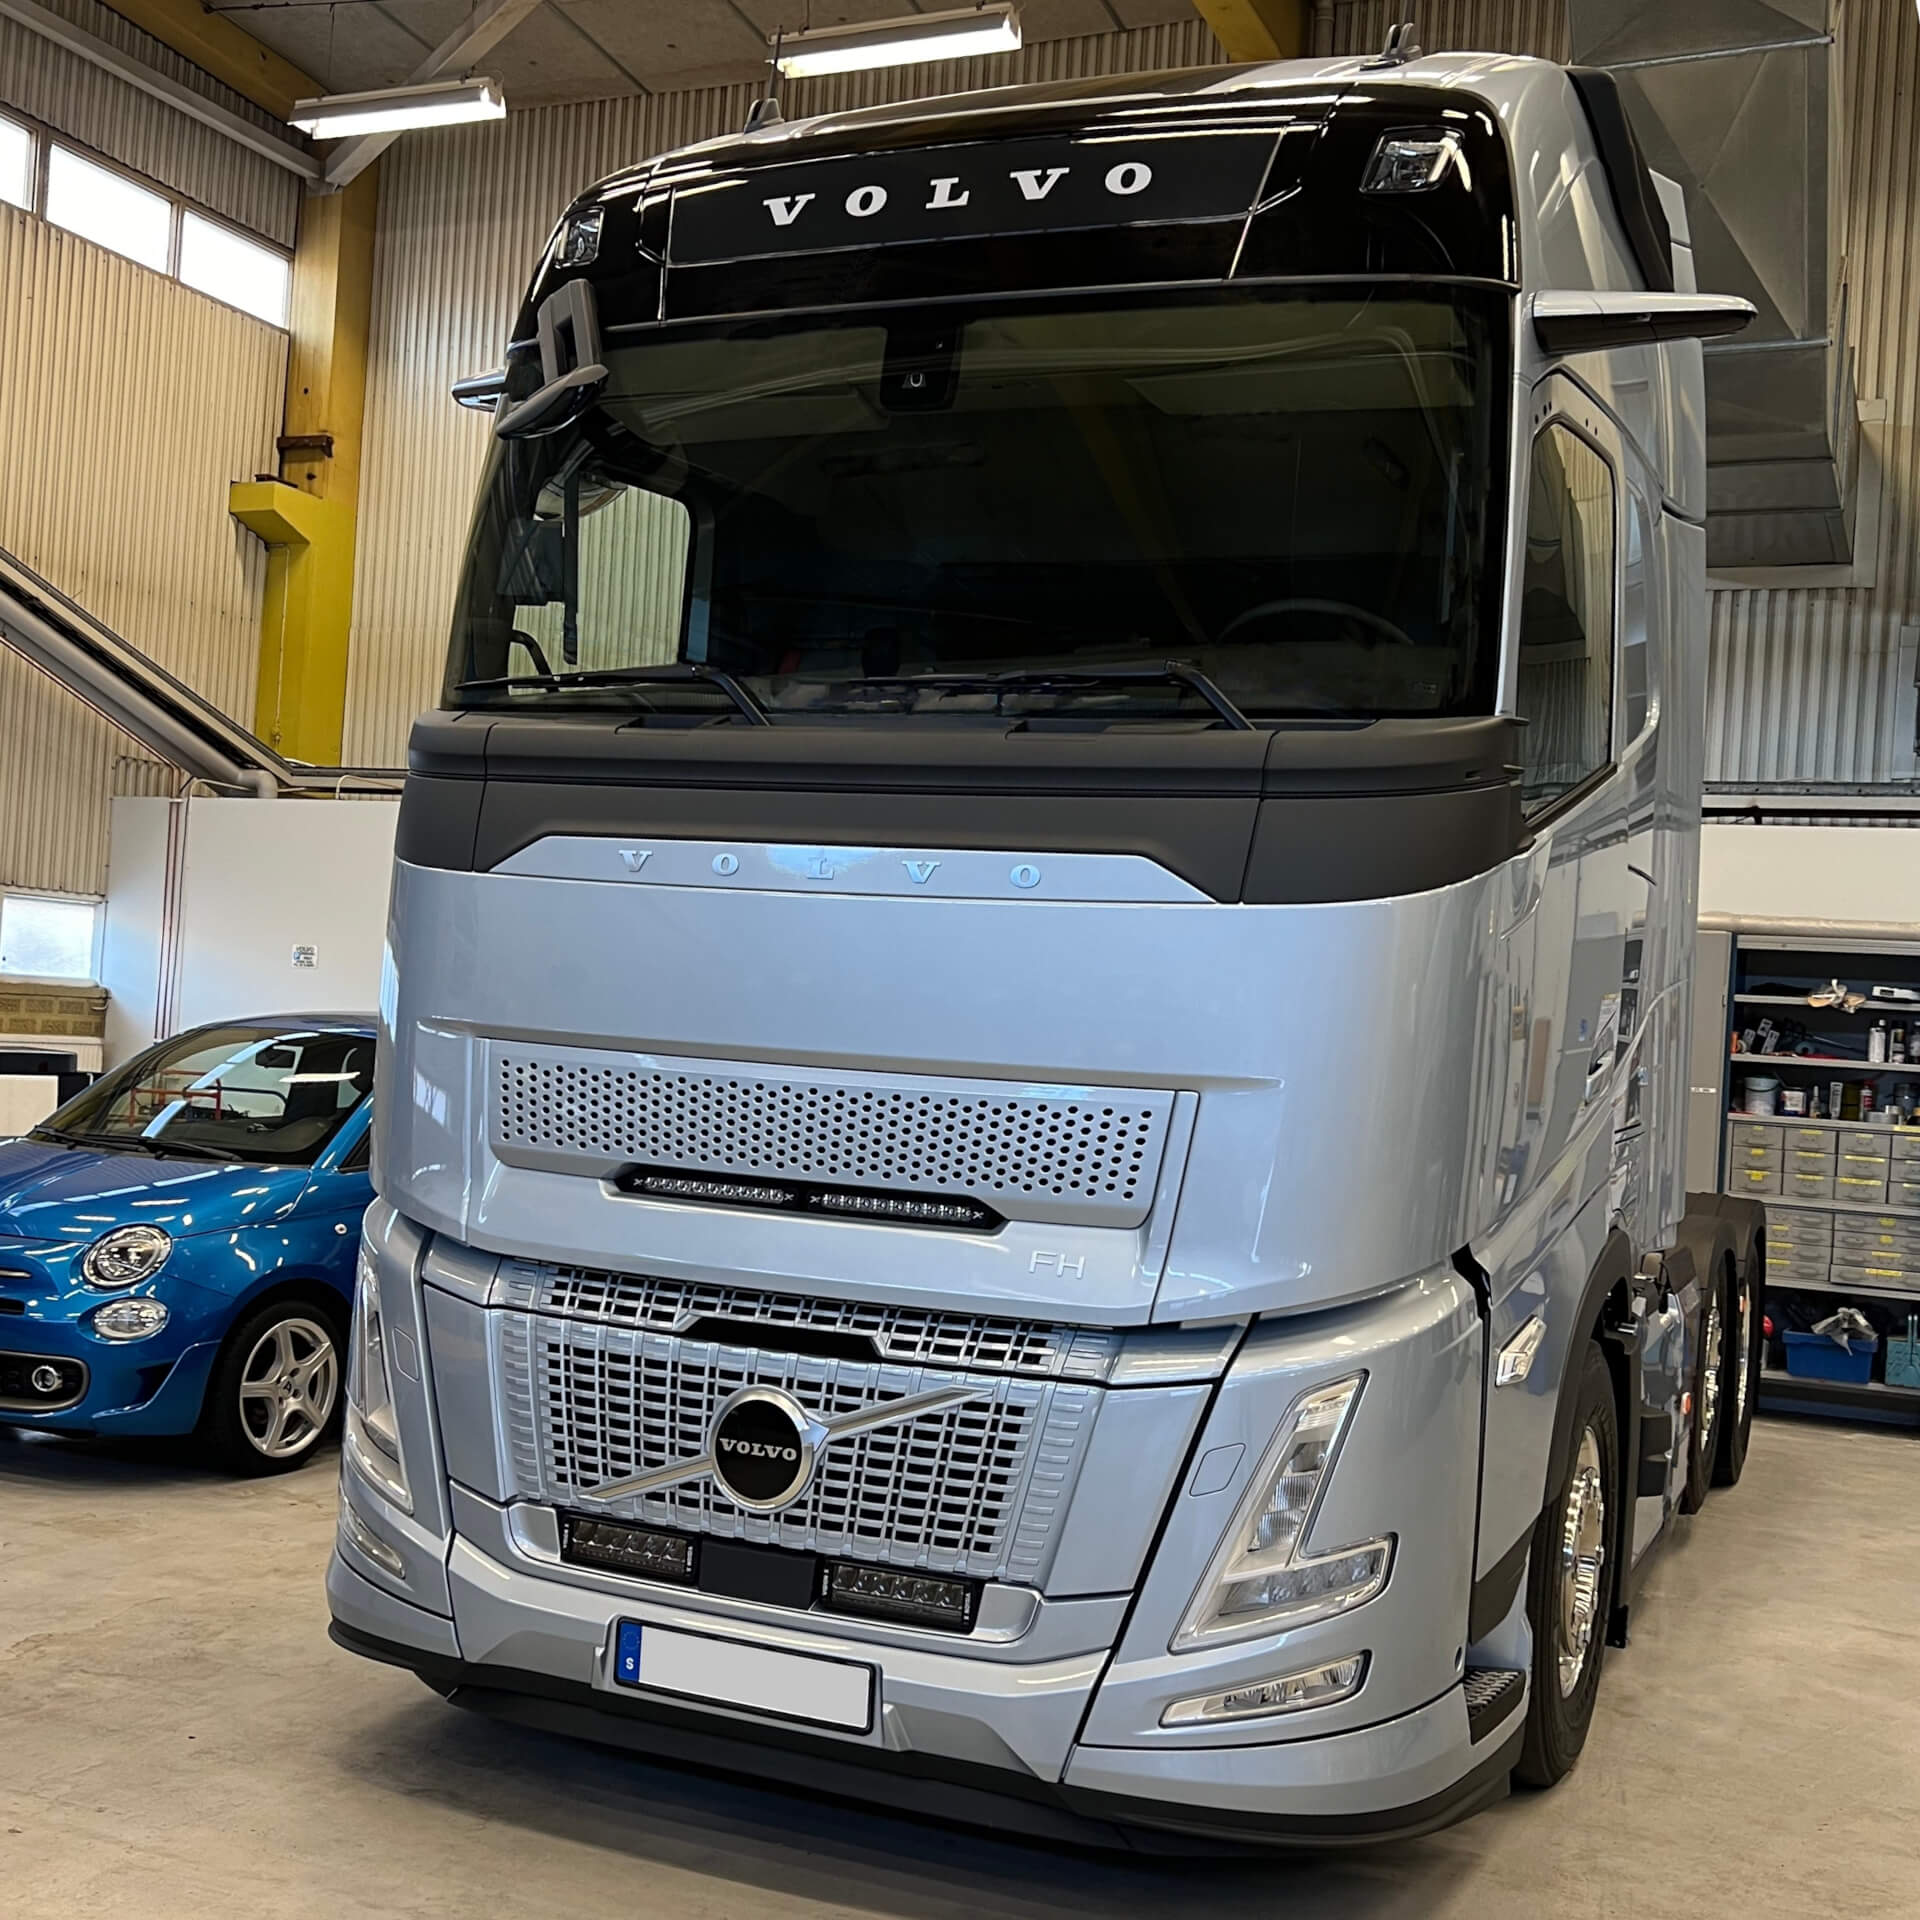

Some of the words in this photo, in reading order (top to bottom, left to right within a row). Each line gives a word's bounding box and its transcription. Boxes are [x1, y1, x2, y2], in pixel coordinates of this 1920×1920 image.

[763, 161, 1153, 226] VOLVO
[618, 849, 1042, 889] VOLVO
[1028, 1250, 1086, 1280] FH
[719, 1437, 798, 1462] VOLVO
[625, 1656, 635, 1670] S
